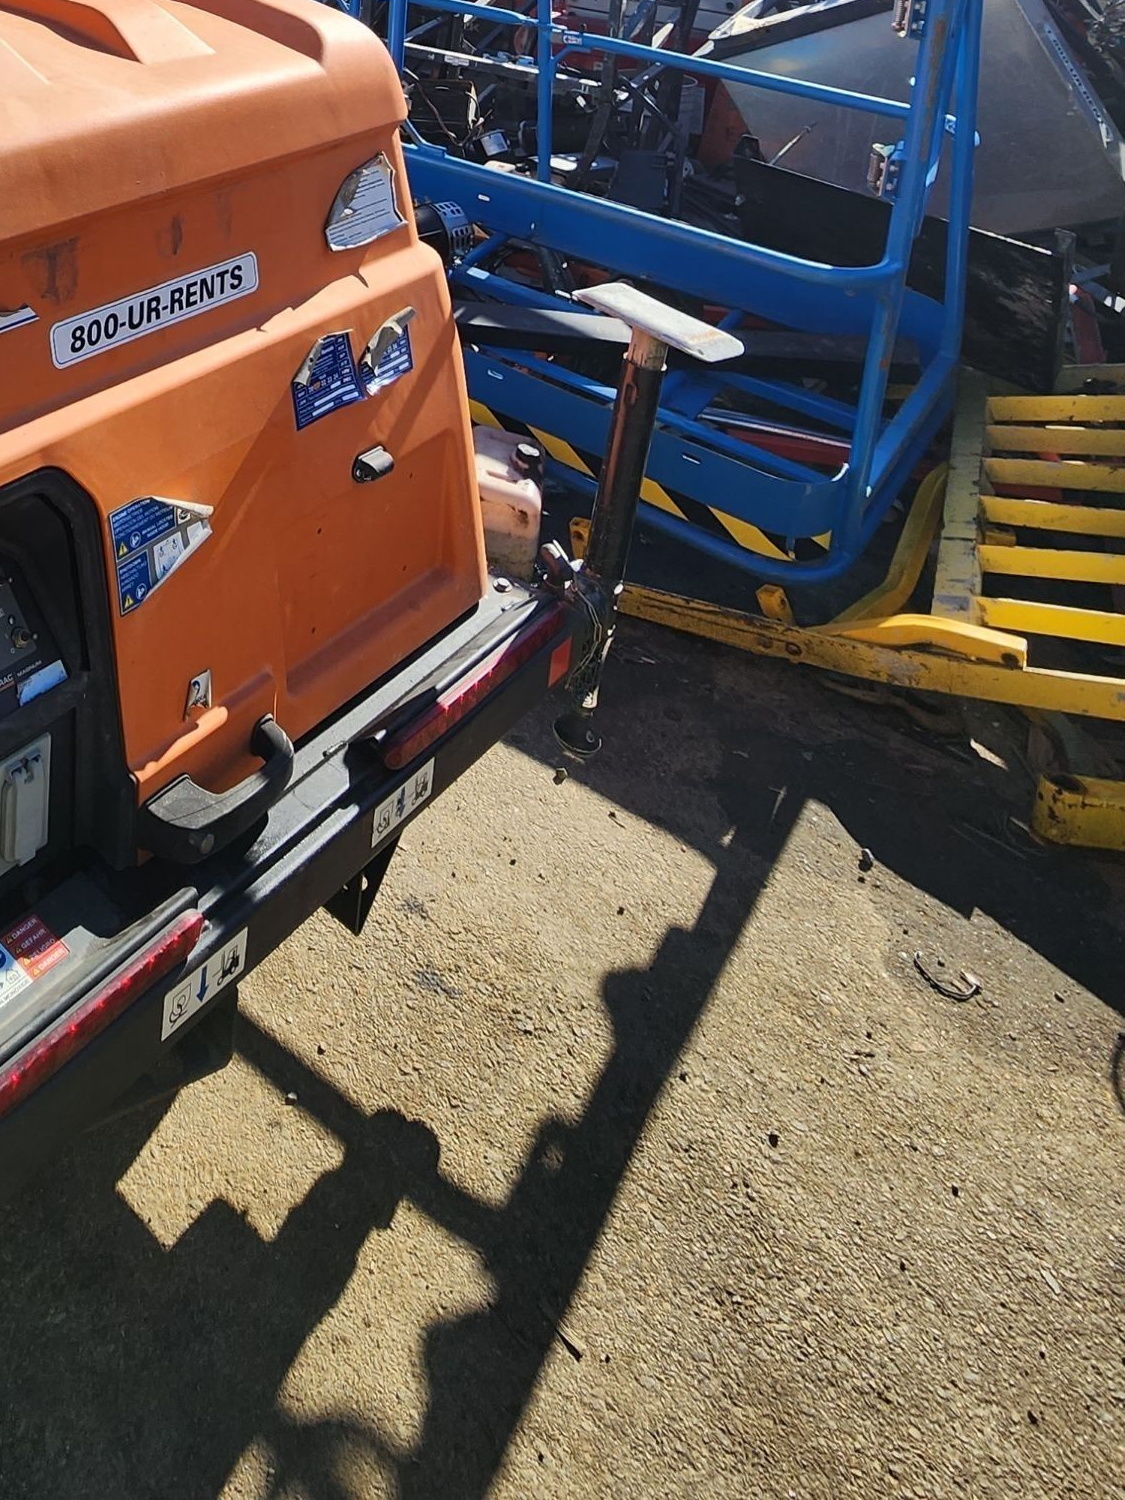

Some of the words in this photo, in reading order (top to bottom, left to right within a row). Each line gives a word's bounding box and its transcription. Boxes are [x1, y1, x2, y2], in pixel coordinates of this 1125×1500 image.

[70, 264, 244, 354] 800-UR-RENTS
[11, 918, 37, 940] DANGER
[20, 928, 47, 949] GEFAHR
[37, 947, 66, 971] DANGER
